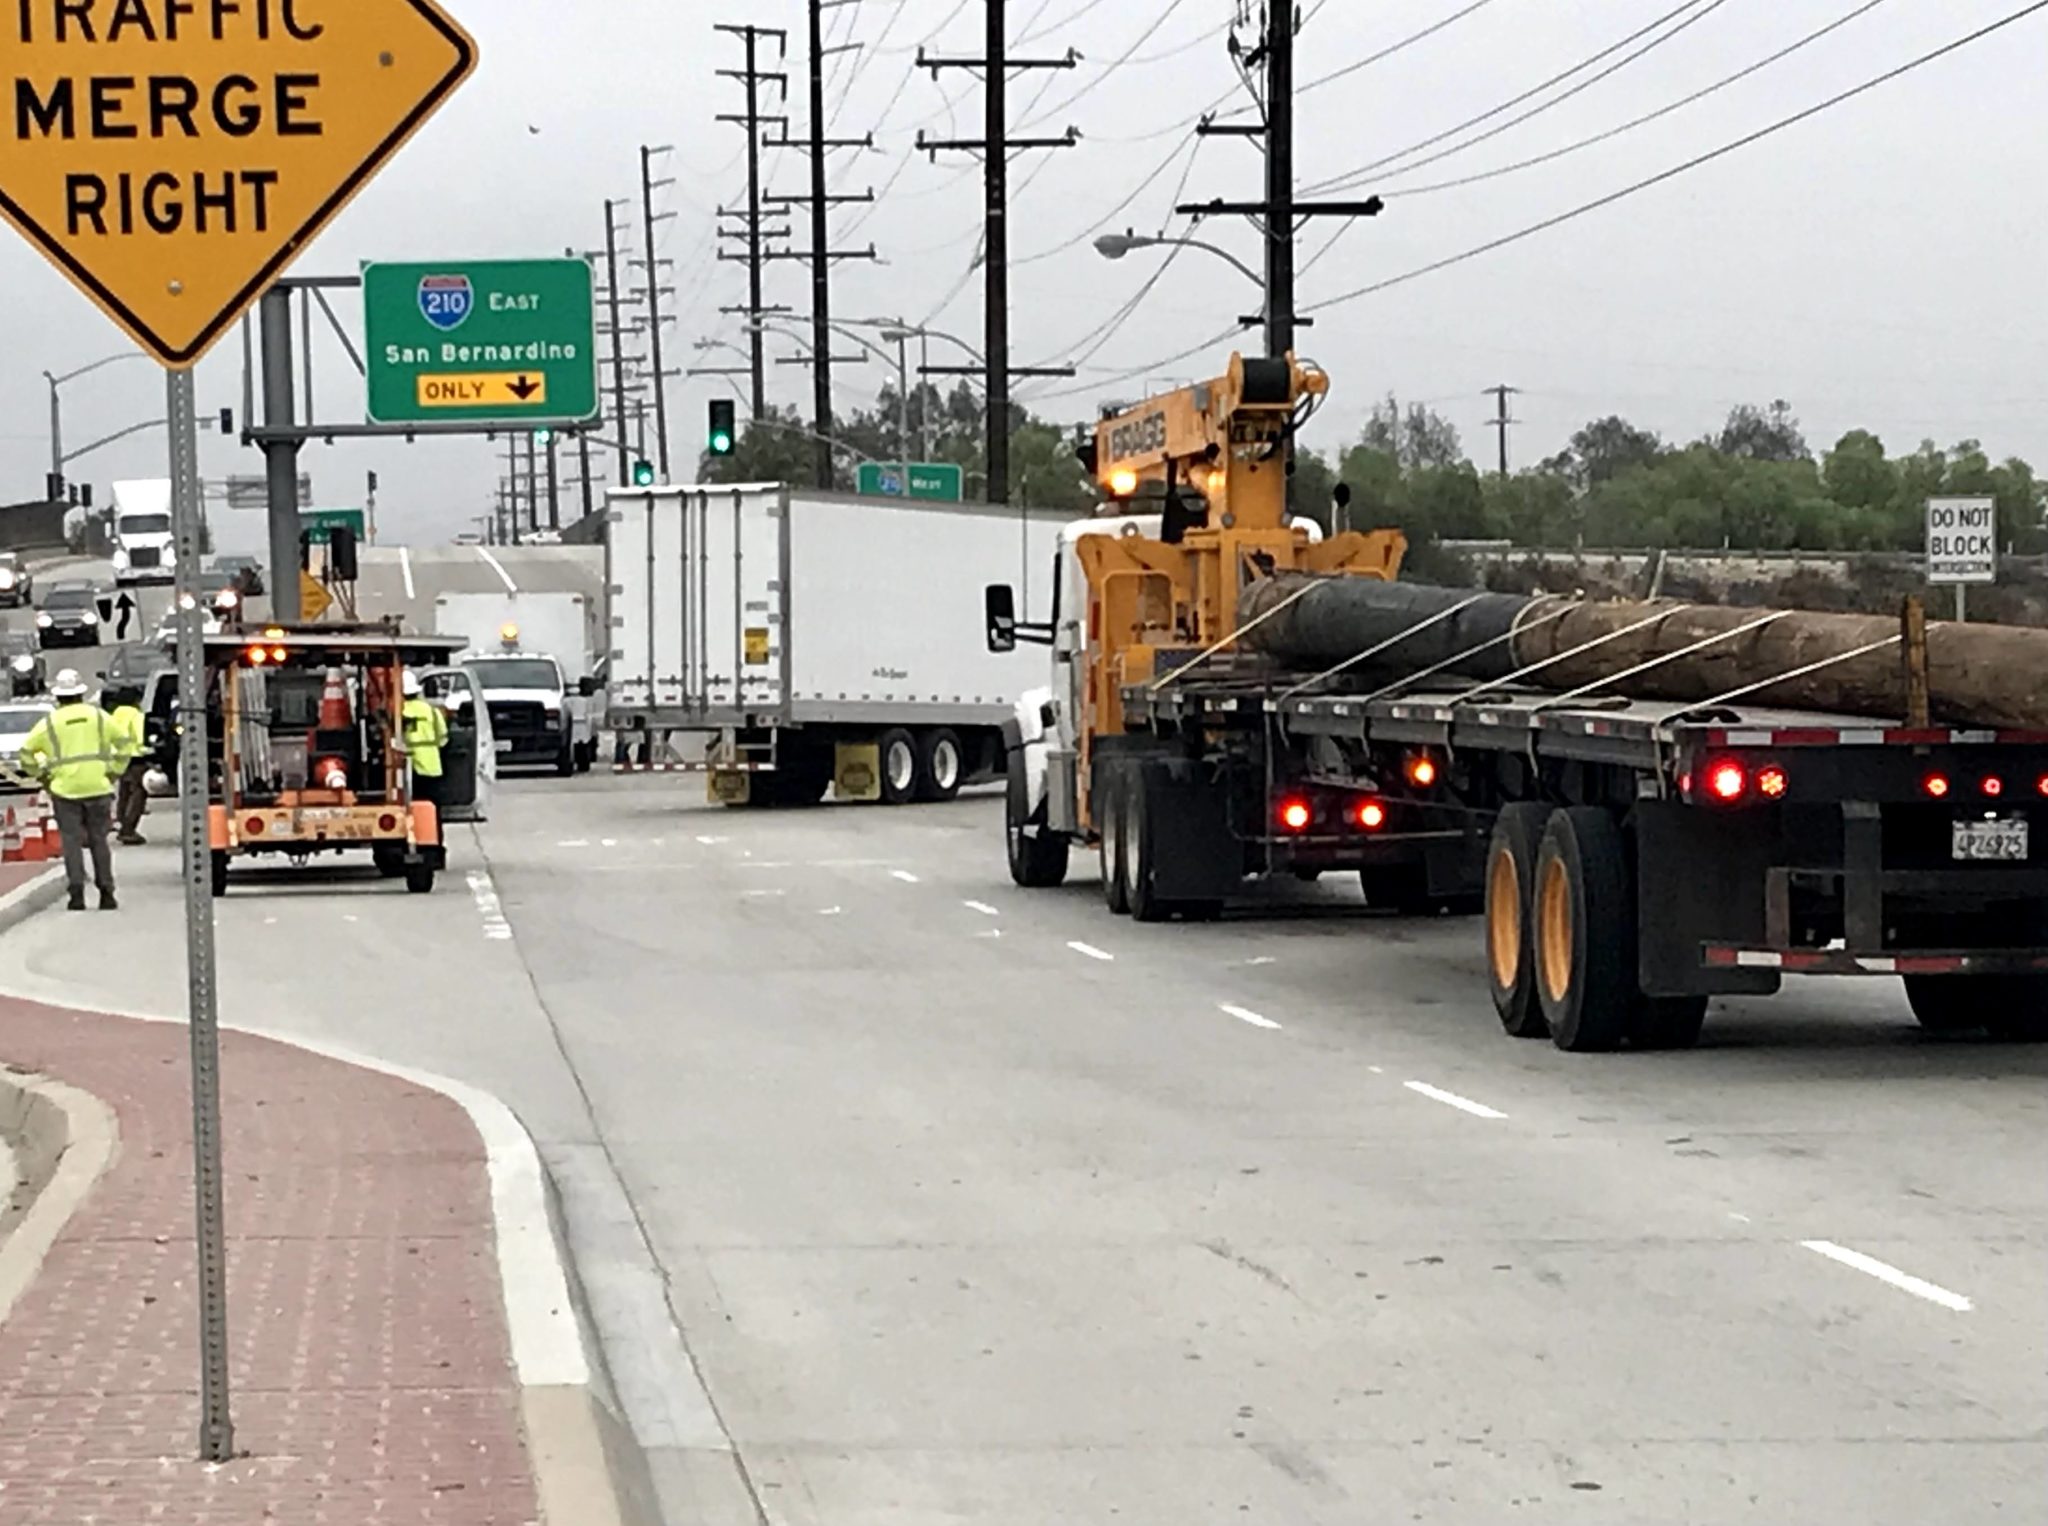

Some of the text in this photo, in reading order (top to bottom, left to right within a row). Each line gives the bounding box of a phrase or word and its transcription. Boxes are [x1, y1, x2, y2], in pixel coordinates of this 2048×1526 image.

[18, 0, 324, 43] TRAFFIC
[15, 73, 323, 140] MERGE
[65, 170, 279, 236] RIGHT
[427, 292, 540, 314] 210 EAST
[385, 341, 577, 364] San Bernardino
[424, 381, 485, 399] ONLY
[1931, 507, 1991, 529] DO NOT
[1931, 535, 1991, 556] BLOCK
